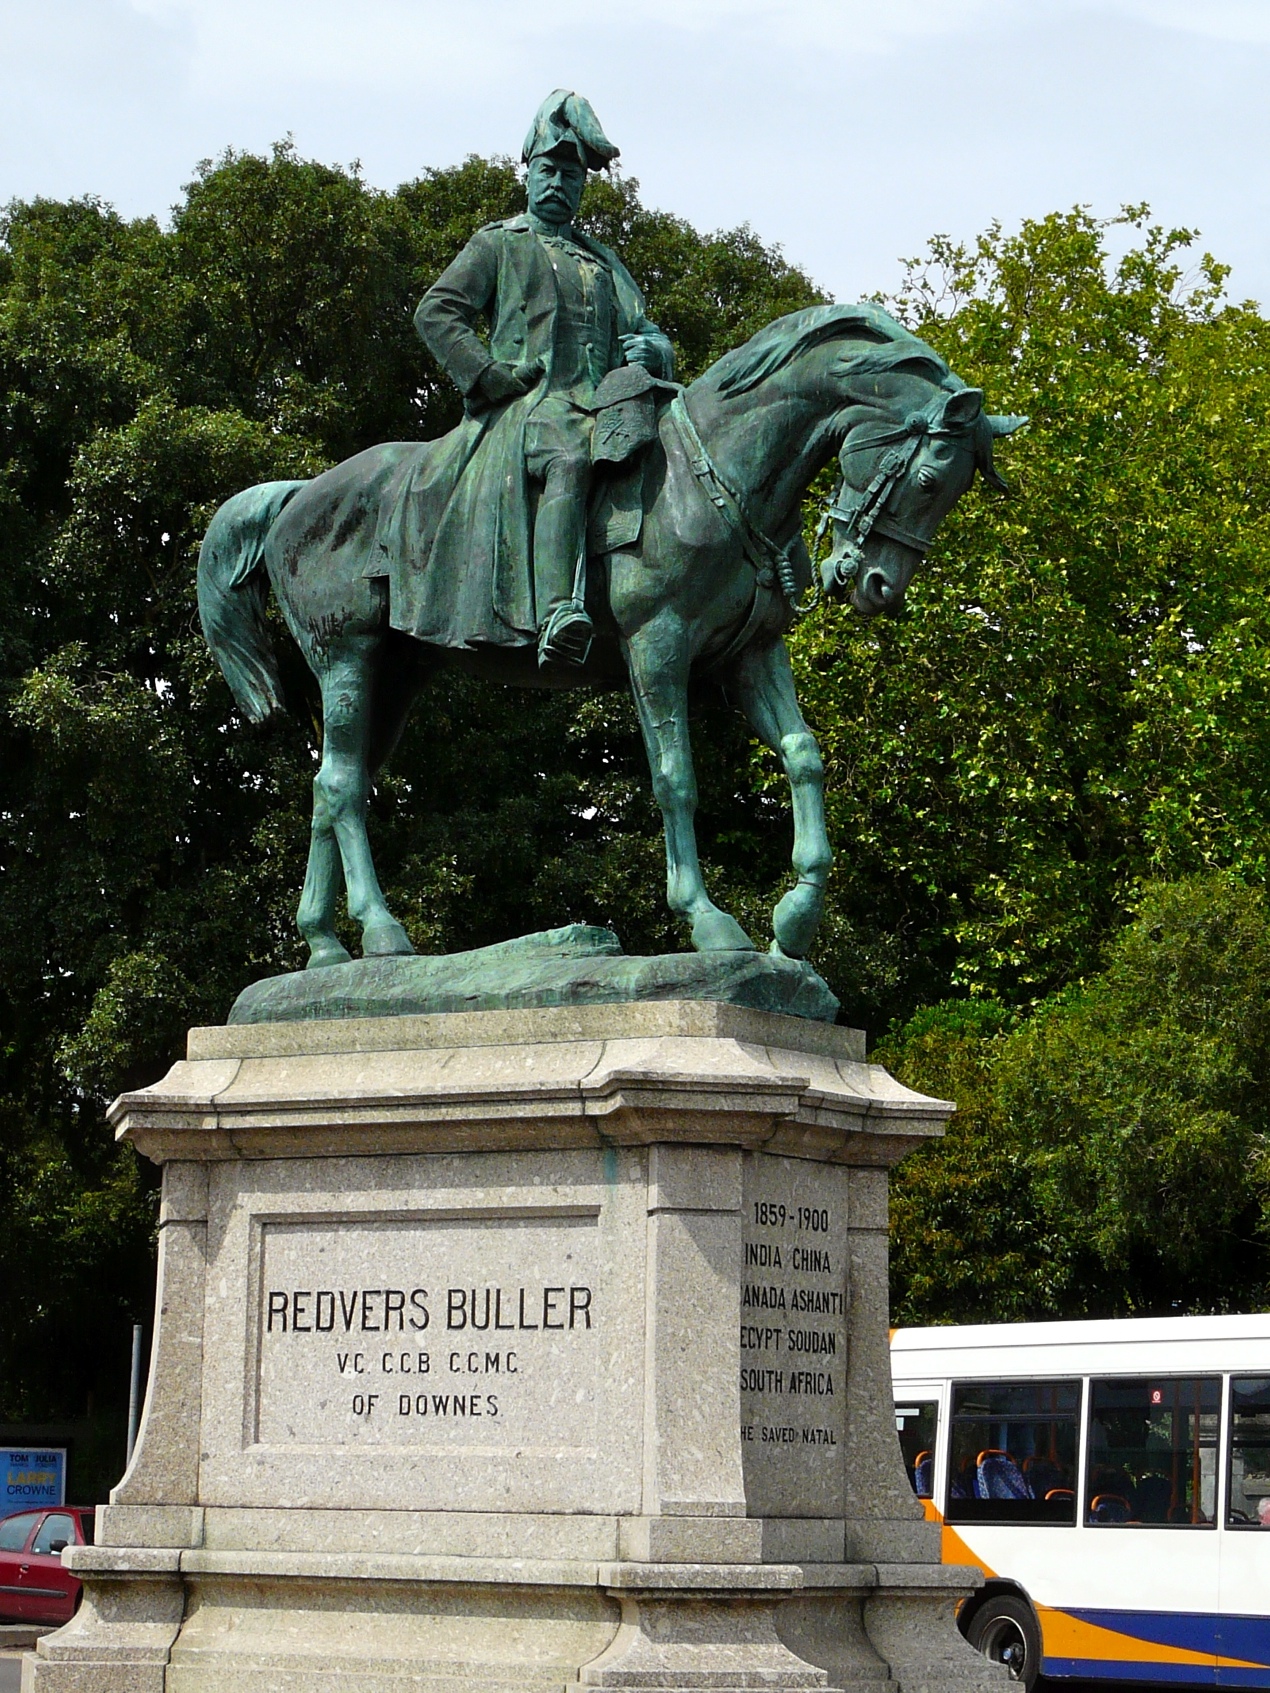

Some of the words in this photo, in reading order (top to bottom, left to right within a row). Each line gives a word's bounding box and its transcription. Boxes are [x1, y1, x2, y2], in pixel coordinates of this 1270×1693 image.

[745, 1243, 782, 1268] INDIA
[793, 1248, 831, 1273] CHINA
[267, 1289, 430, 1332] REDVERS
[446, 1286, 592, 1331] BULLER
[740, 1284, 786, 1309] ANADA
[791, 1289, 843, 1315] ASHANTI
[788, 1330, 836, 1355] SOUDAN
[740, 1369, 783, 1393] SOUTH
[789, 1372, 833, 1396] AFRICA
[352, 1395, 379, 1416] OF
[762, 1427, 795, 1443] SAVED
[802, 1429, 836, 1445] NATAL
[9, 1454, 29, 1462] TOM
[36, 1454, 57, 1463] JULIA
[7, 1485, 56, 1495] CROWNE
